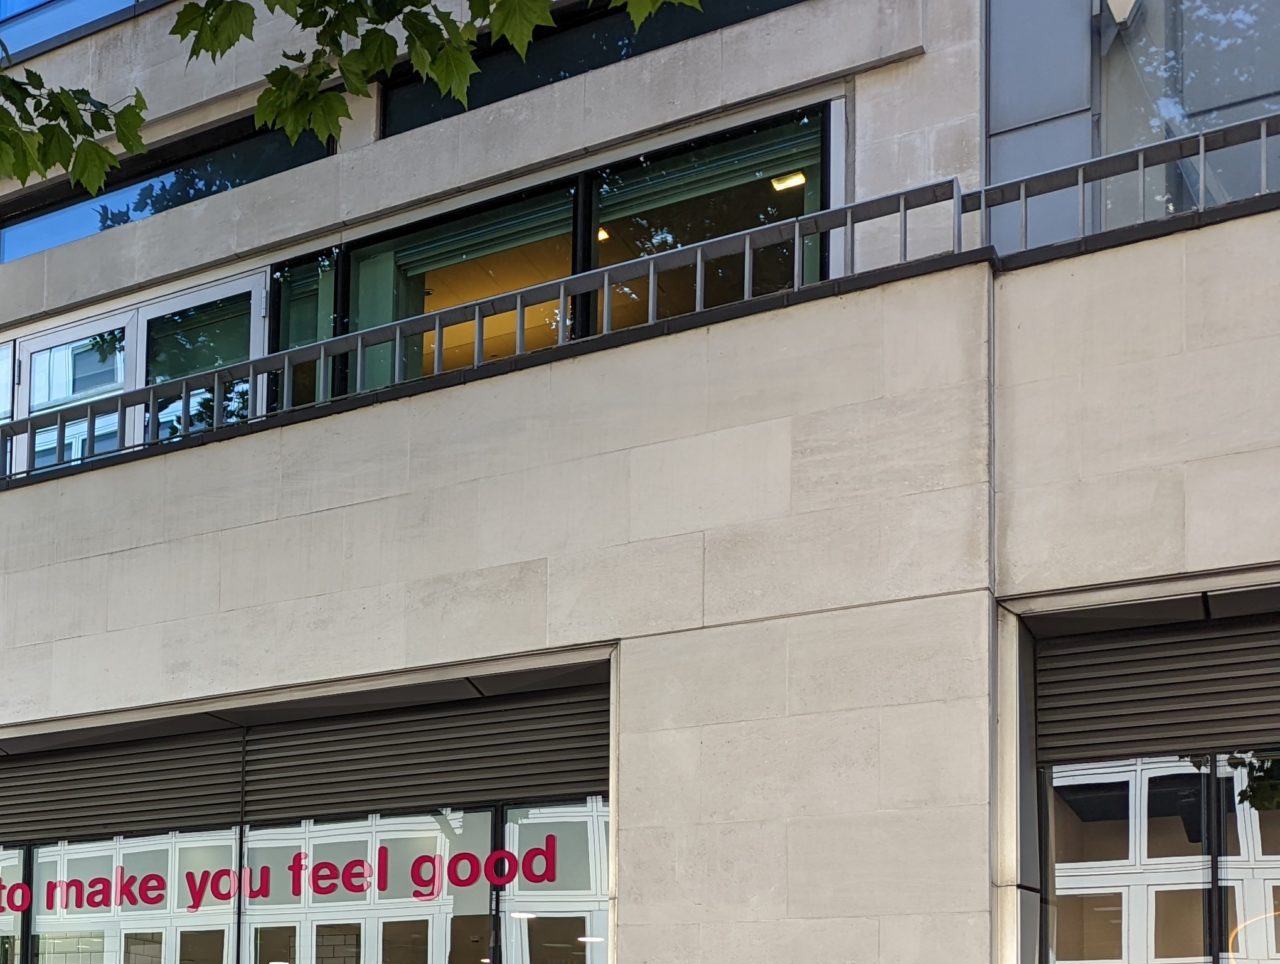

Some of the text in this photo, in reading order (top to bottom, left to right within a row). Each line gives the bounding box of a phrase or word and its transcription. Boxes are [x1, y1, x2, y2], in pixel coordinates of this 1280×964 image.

[45, 866, 167, 910] make
[185, 866, 270, 912] you
[288, 846, 389, 896] feel
[411, 834, 557, 901] good
